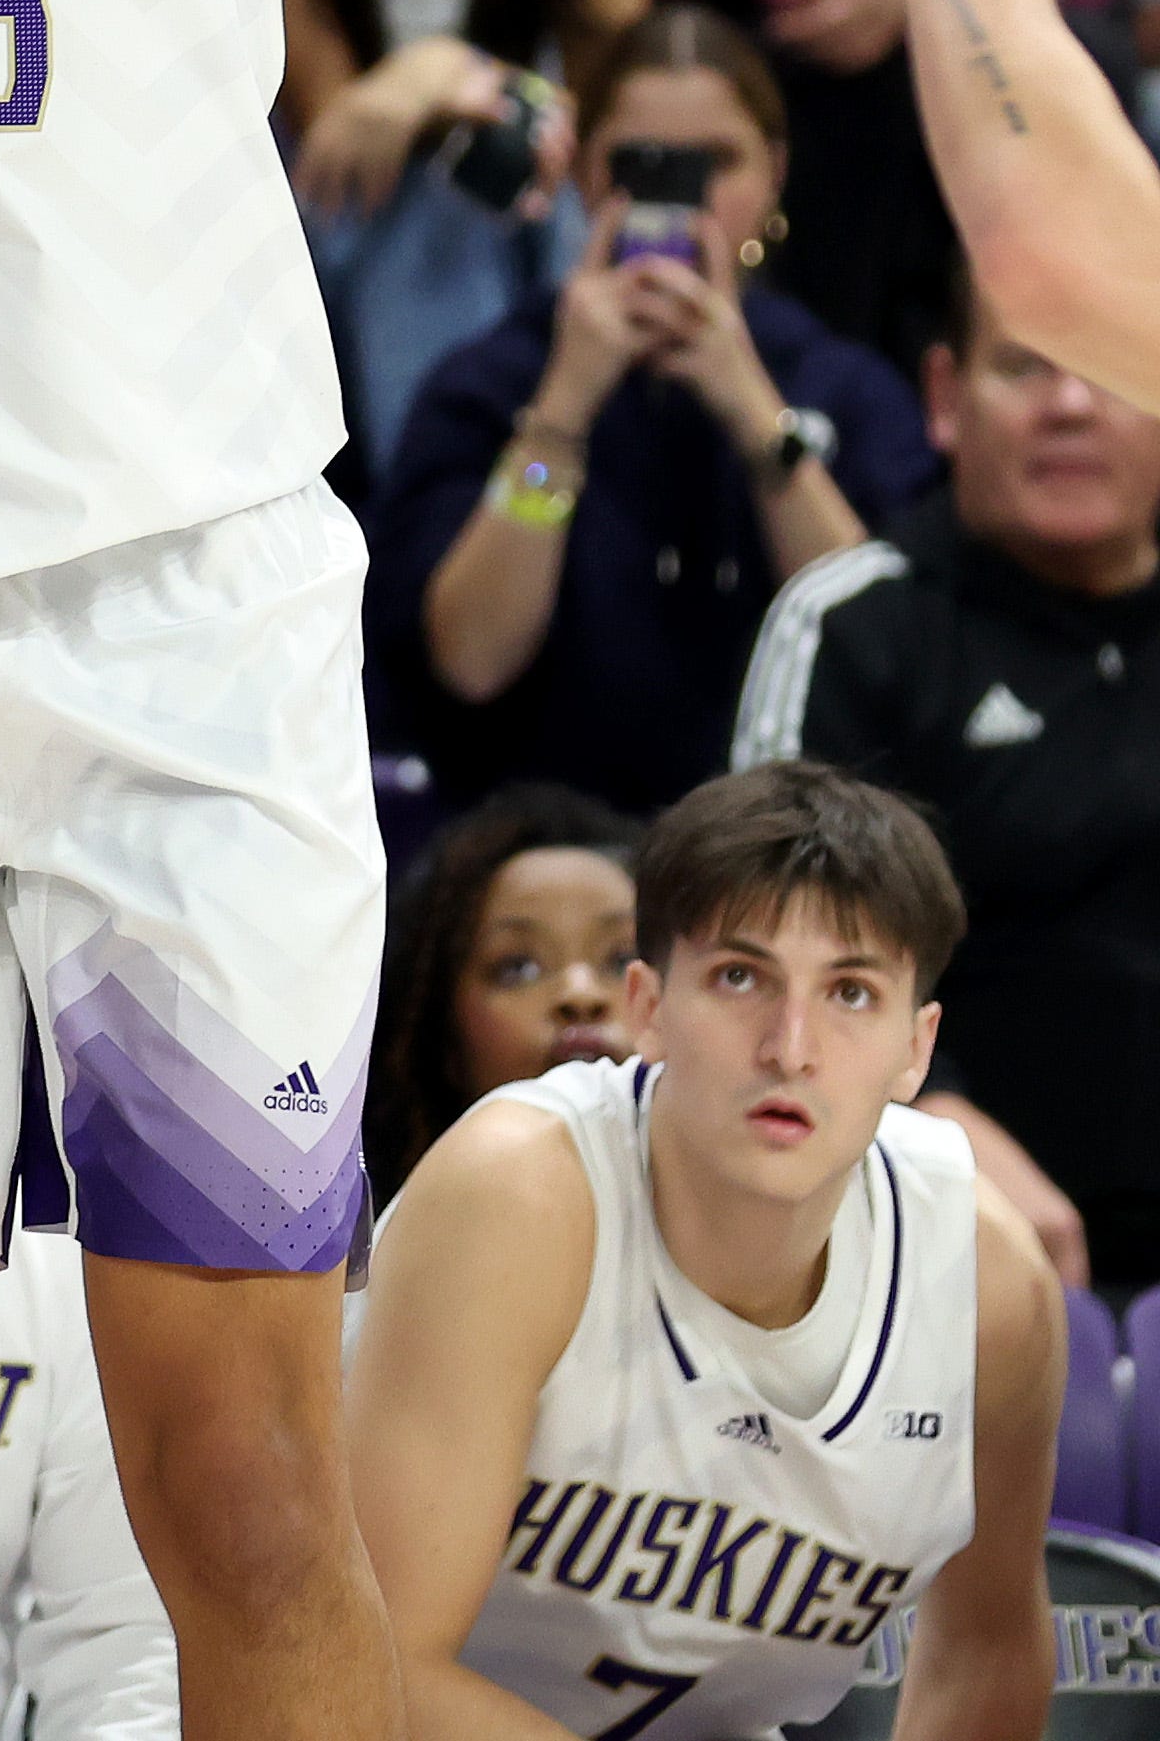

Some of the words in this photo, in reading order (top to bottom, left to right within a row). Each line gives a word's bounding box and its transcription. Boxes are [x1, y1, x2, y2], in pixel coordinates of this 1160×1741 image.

[263, 1092, 328, 1115] adidas
[505, 1479, 911, 1647] HUSKIES
[584, 1653, 702, 1741] 7
